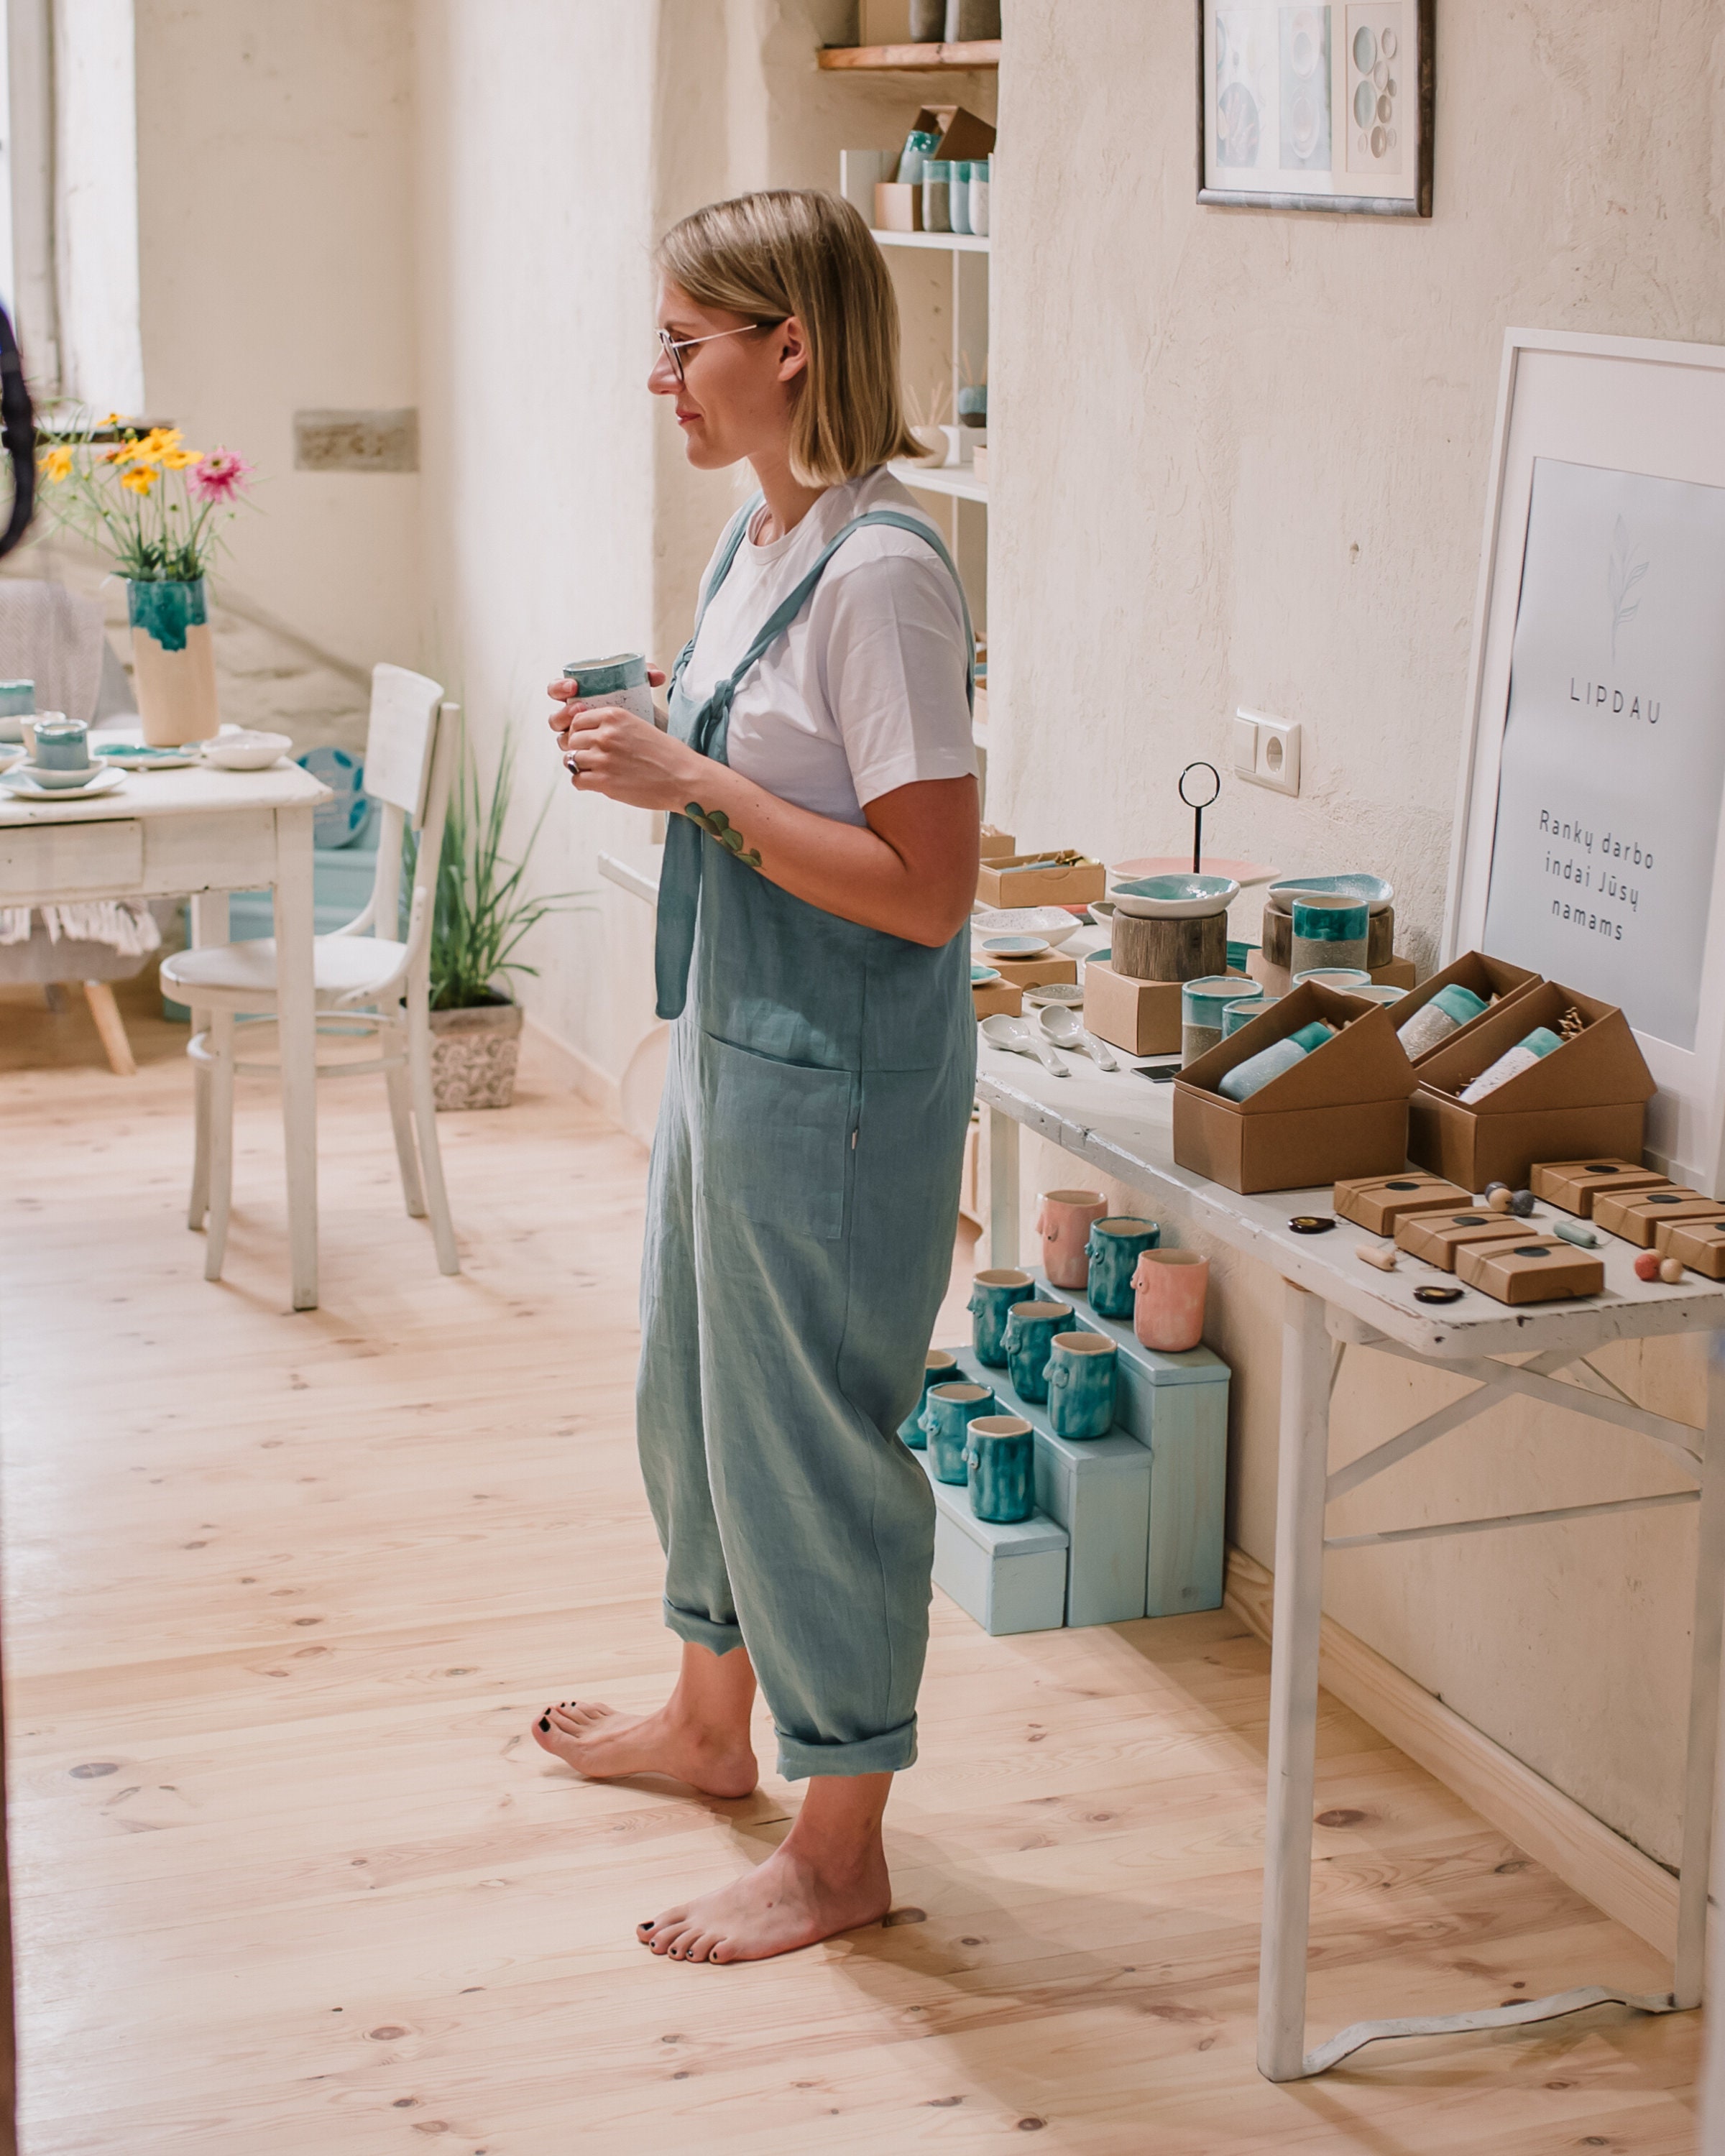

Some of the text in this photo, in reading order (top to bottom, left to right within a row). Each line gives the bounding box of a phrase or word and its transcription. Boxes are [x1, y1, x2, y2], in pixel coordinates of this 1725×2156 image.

[1570, 677, 1660, 724] LIPDAU
[1539, 808, 1653, 870] Rankų darbo
[1545, 850, 1639, 913] indai Jūsų
[1551, 899, 1623, 941] namams
